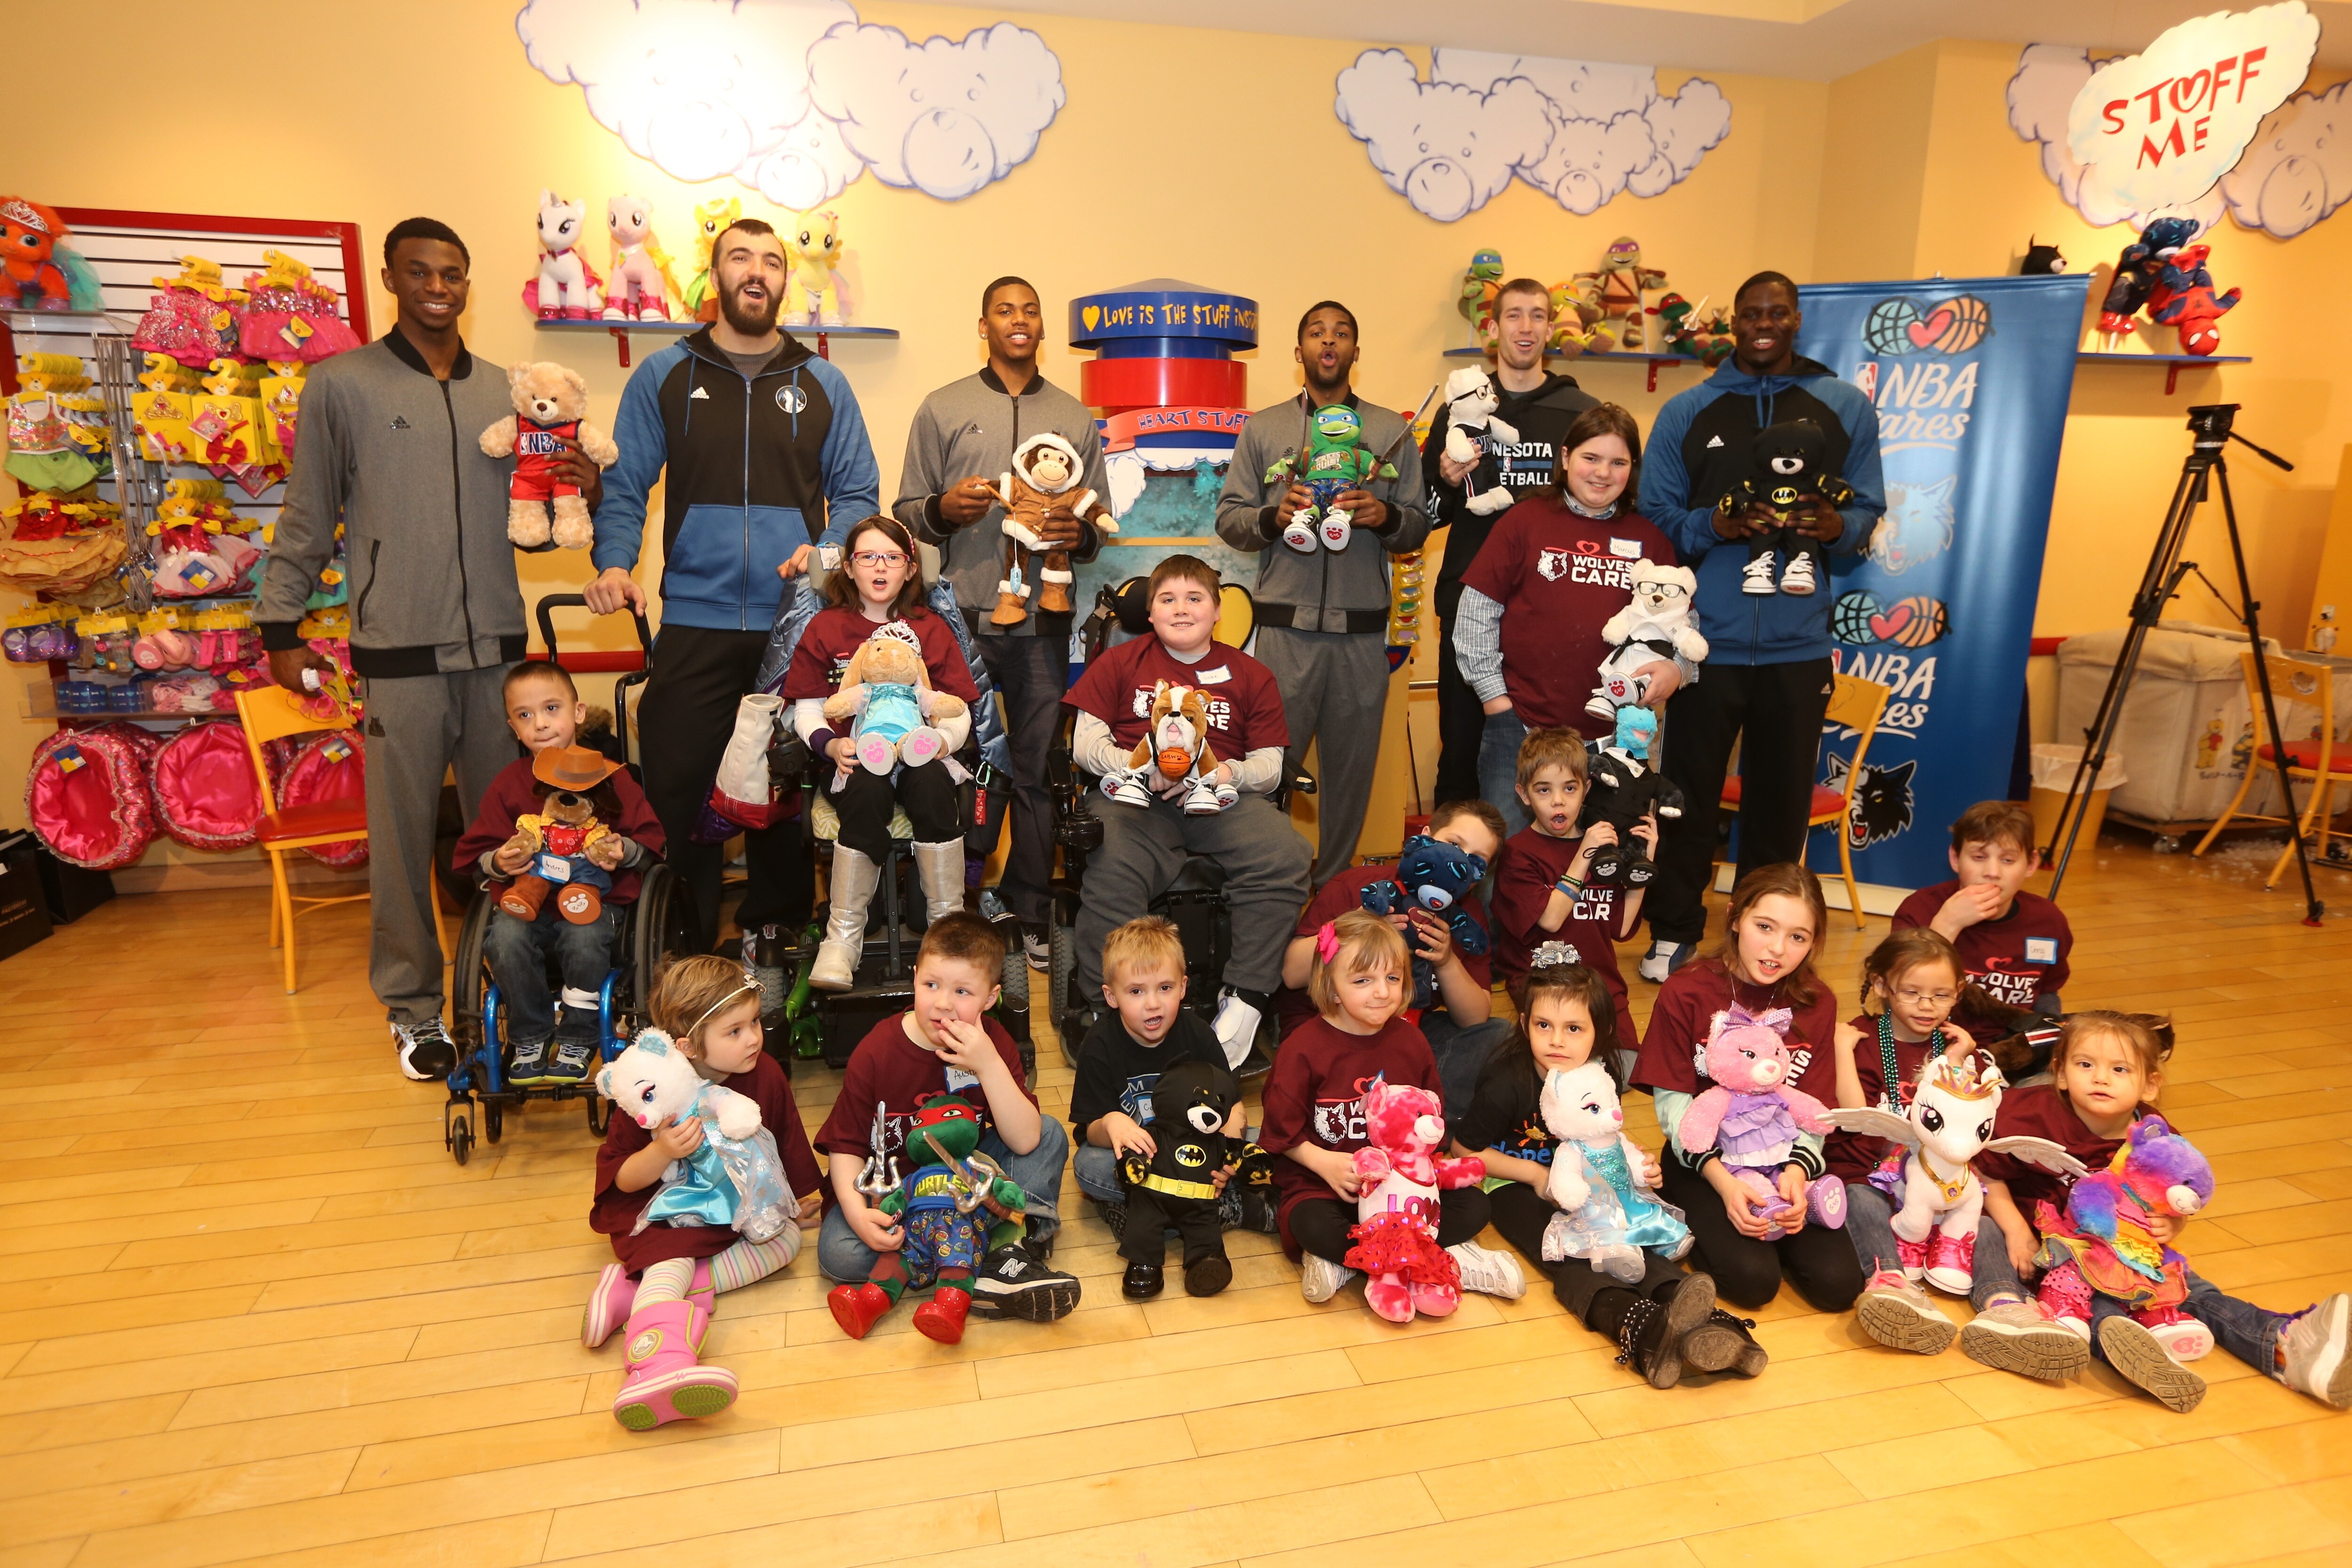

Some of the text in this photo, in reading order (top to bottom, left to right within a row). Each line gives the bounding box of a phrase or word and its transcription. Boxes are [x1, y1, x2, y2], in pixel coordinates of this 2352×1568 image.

[2137, 116, 2210, 169] ME
[1104, 306, 1133, 328] LOVE
[1164, 304, 1186, 325] THE
[1193, 304, 1230, 328] STUFF
[1876, 362, 1979, 409] NBA
[1138, 410, 1192, 430] HEART
[1876, 408, 1971, 441] ares
[1475, 435, 1493, 454] NB
[1492, 442, 1553, 457] NESOTA
[1499, 472, 1552, 486] ETBALL
[1613, 544, 1636, 556] Marcus
[1572, 554, 1636, 573] WOLVES
[1847, 652, 1938, 700] NBA
[1205, 713, 1230, 731] RE
[546, 860, 564, 873] Andres
[1977, 983, 2034, 1004] ARE
[954, 1070, 977, 1080] Austi
[998, 1258, 1028, 1278] N
